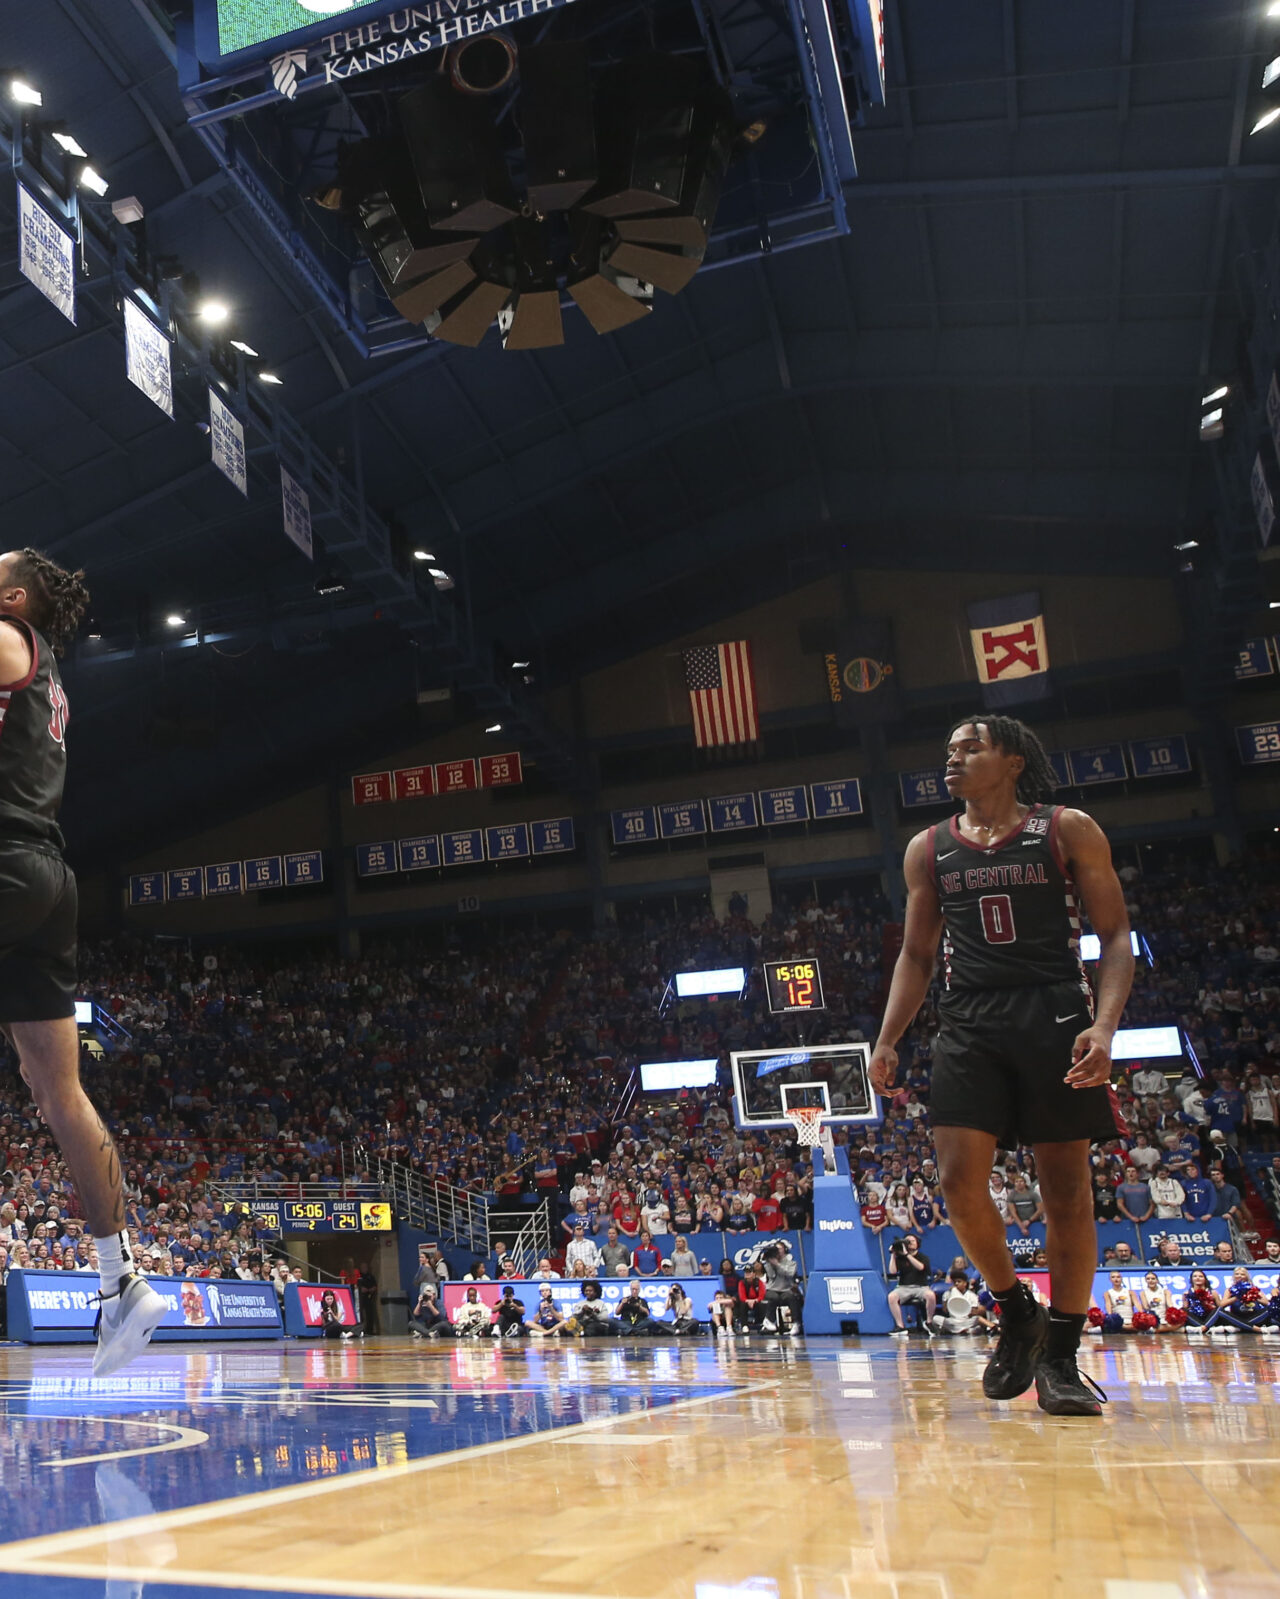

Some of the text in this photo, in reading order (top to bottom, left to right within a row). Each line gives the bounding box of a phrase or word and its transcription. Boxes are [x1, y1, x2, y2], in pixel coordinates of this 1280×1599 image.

[322, 22, 382, 58] THE
[324, 31, 431, 84] KANSAS
[1151, 747, 1170, 766] 10
[491, 764, 509, 779] 33
[1092, 756, 1104, 773] 4
[406, 776, 421, 791] 31
[448, 770, 463, 785] 12
[365, 783, 379, 797] 21
[916, 779, 937, 796] 45
[773, 797, 795, 815] 25
[829, 791, 844, 808] 11
[673, 811, 691, 828] 15
[724, 805, 741, 821] 14
[625, 817, 645, 833] 40
[500, 835, 515, 850] 13
[544, 829, 560, 844] 15
[412, 846, 427, 861] 13
[453, 840, 472, 855] 32
[368, 852, 385, 866] 25
[256, 867, 270, 881] 15
[296, 862, 310, 876] 16
[181, 877, 189, 891] 5
[216, 873, 230, 887] 10
[940, 863, 1049, 894] NC CENTRAL
[143, 883, 152, 896] 5
[978, 894, 1017, 945] 0
[776, 964, 815, 982] 15:06
[788, 980, 813, 1006] 12
[252, 1203, 279, 1211] KANSAS
[291, 1204, 323, 1217] 15:06
[333, 1203, 355, 1211] GUEST
[309, 1220, 315, 1230] 2
[339, 1215, 355, 1228] 24
[1005, 1238, 1033, 1248] LACK
[28, 1289, 70, 1310] HERE'S
[71, 1290, 87, 1310] TO
[220, 1293, 232, 1304] THE
[231, 1294, 260, 1306] UNIVERSITY
[223, 1305, 278, 1319] KANSAS HEALTH SYSTEM
